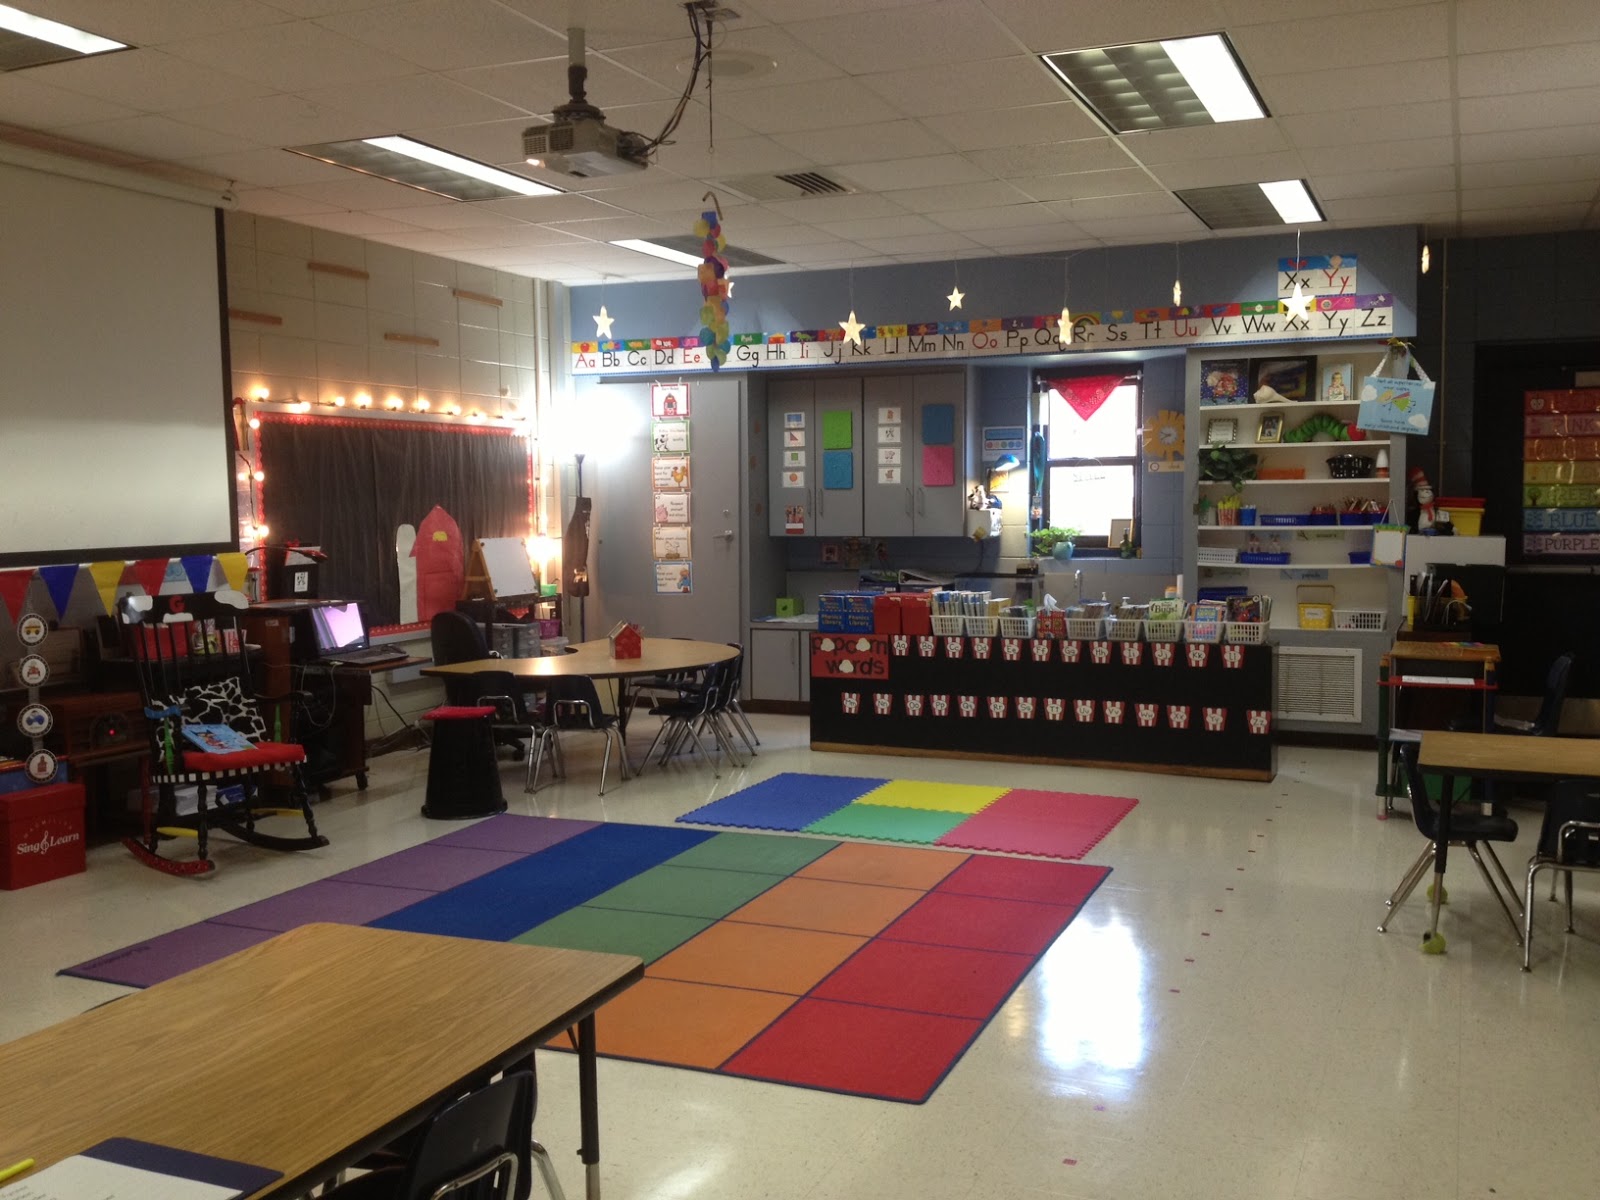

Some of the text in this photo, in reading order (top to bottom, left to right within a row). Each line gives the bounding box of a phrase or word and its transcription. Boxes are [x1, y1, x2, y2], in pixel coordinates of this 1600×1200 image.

[1284, 268, 1349, 295] Xx Yy
[575, 353, 595, 368] Aa
[602, 351, 620, 367] Bb
[627, 350, 647, 366] Cc
[655, 349, 674, 365] Dd
[683, 347, 701, 363] Ee
[737, 344, 759, 368] Gg
[766, 343, 786, 360] Hh
[800, 341, 809, 359] Ii
[823, 341, 842, 365] Jj
[851, 338, 871, 356] Kk
[884, 337, 899, 354] Ll
[908, 335, 936, 352] Mm
[943, 334, 964, 351] Nn
[972, 331, 998, 349] Oo
[1006, 329, 1029, 353] Pp
[1073, 325, 1095, 343] Rr
[1106, 323, 1128, 341] Ss
[1139, 321, 1161, 339] Tt
[1174, 319, 1198, 337] Uu
[1211, 317, 1232, 335] Vv
[1241, 314, 1276, 333] Ww
[1322, 310, 1349, 336] Yy
[1361, 308, 1387, 327] Zz
[1549, 512, 1597, 529] BLUE
[1545, 538, 1600, 551] PURPLE
[812, 636, 887, 656] ppcrn
[976, 642, 987, 652] Dd
[825, 657, 884, 675] wrds
[17, 832, 80, 855] Sing Learn
